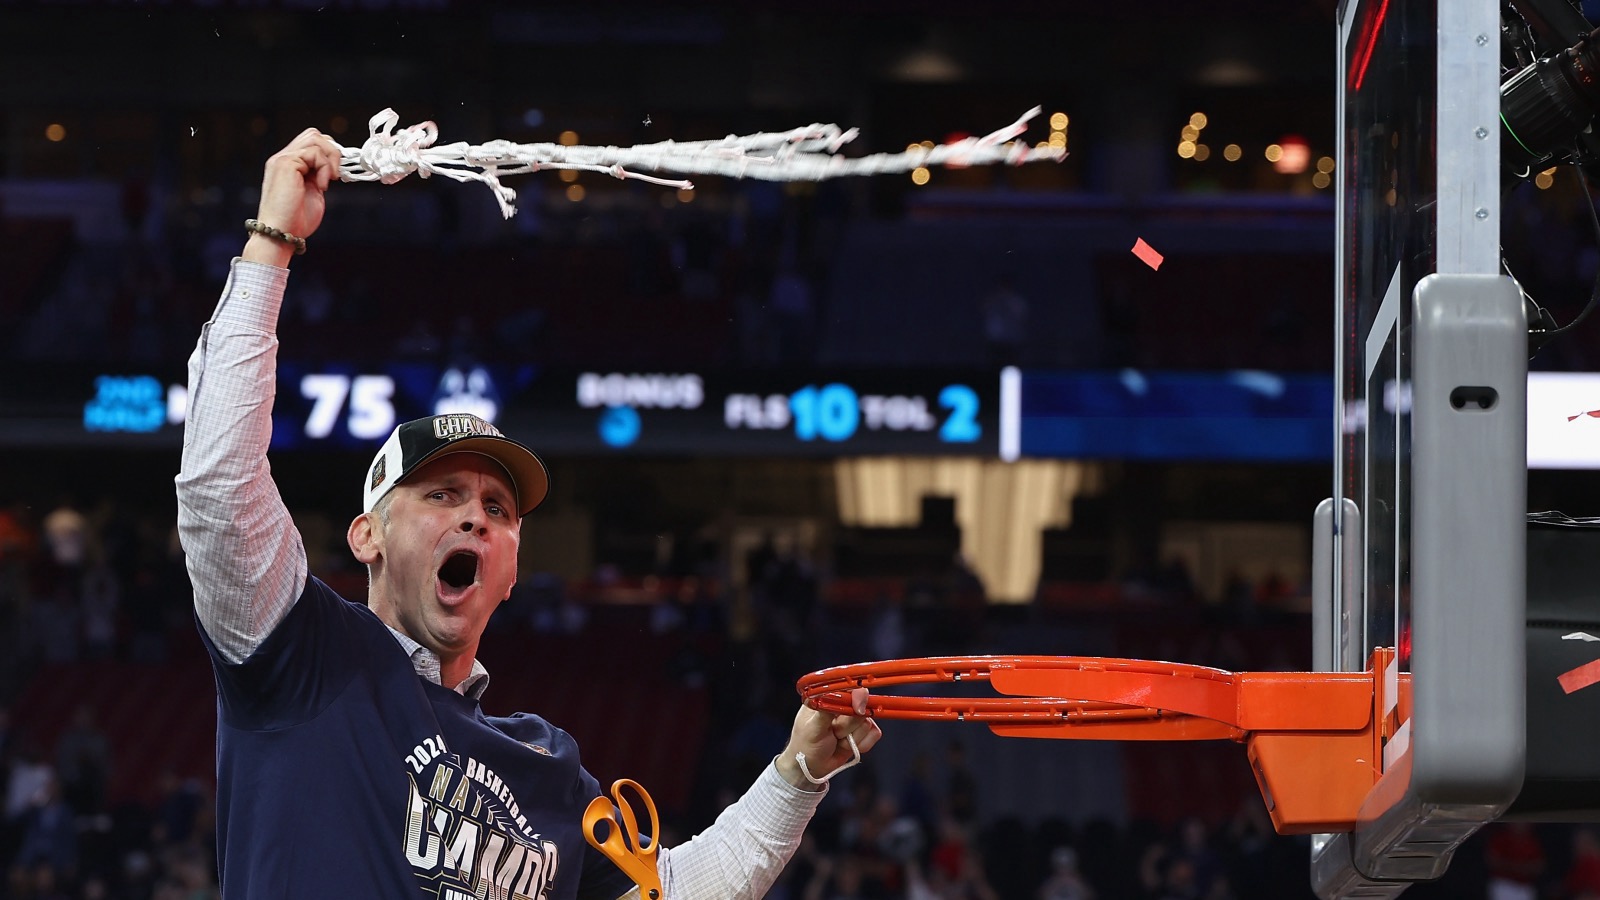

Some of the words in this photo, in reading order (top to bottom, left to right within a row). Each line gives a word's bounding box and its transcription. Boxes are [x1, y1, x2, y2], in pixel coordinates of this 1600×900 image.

[301, 374, 396, 438] 75
[576, 373, 703, 408] BONUS
[724, 395, 790, 429] FLS
[789, 383, 860, 441] 10
[861, 396, 935, 430] TOL
[938, 384, 982, 443] 2
[404, 734, 448, 775] 2024
